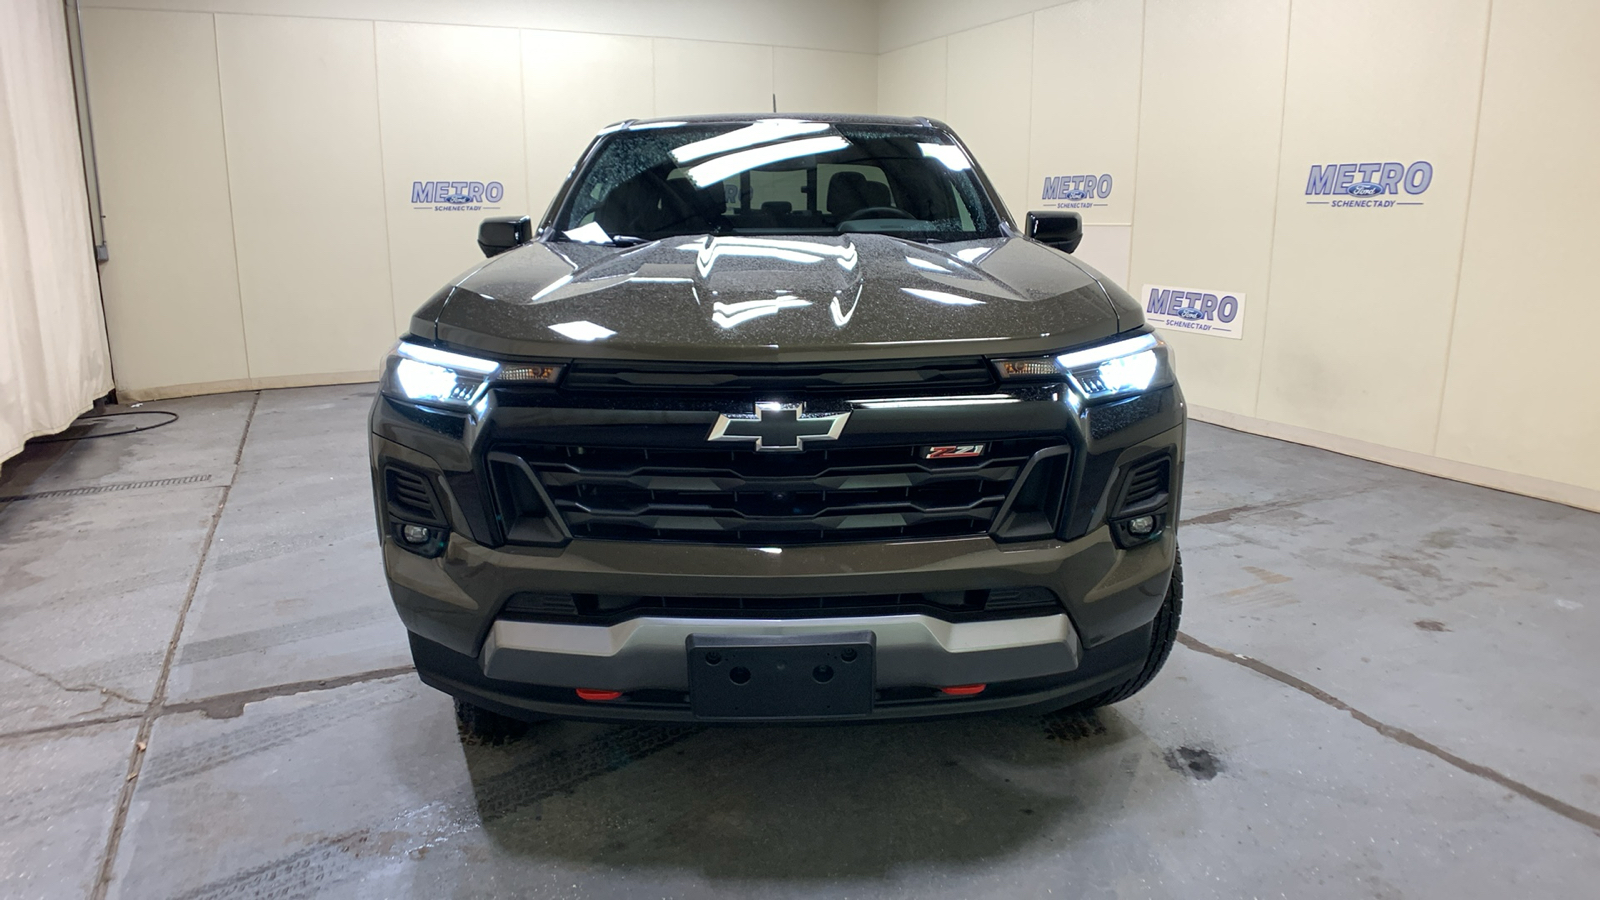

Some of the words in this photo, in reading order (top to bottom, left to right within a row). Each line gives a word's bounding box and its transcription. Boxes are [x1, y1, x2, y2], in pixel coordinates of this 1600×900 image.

[1042, 174, 1113, 200] METRO
[1305, 161, 1433, 195] METRO
[411, 181, 504, 203] METRO
[1353, 185, 1376, 195] Ford
[1331, 200, 1396, 208] SCHENECTADY
[1146, 288, 1239, 323] METRO
[1165, 319, 1212, 331] SCHENECTADY
[926, 444, 984, 459] Z71
